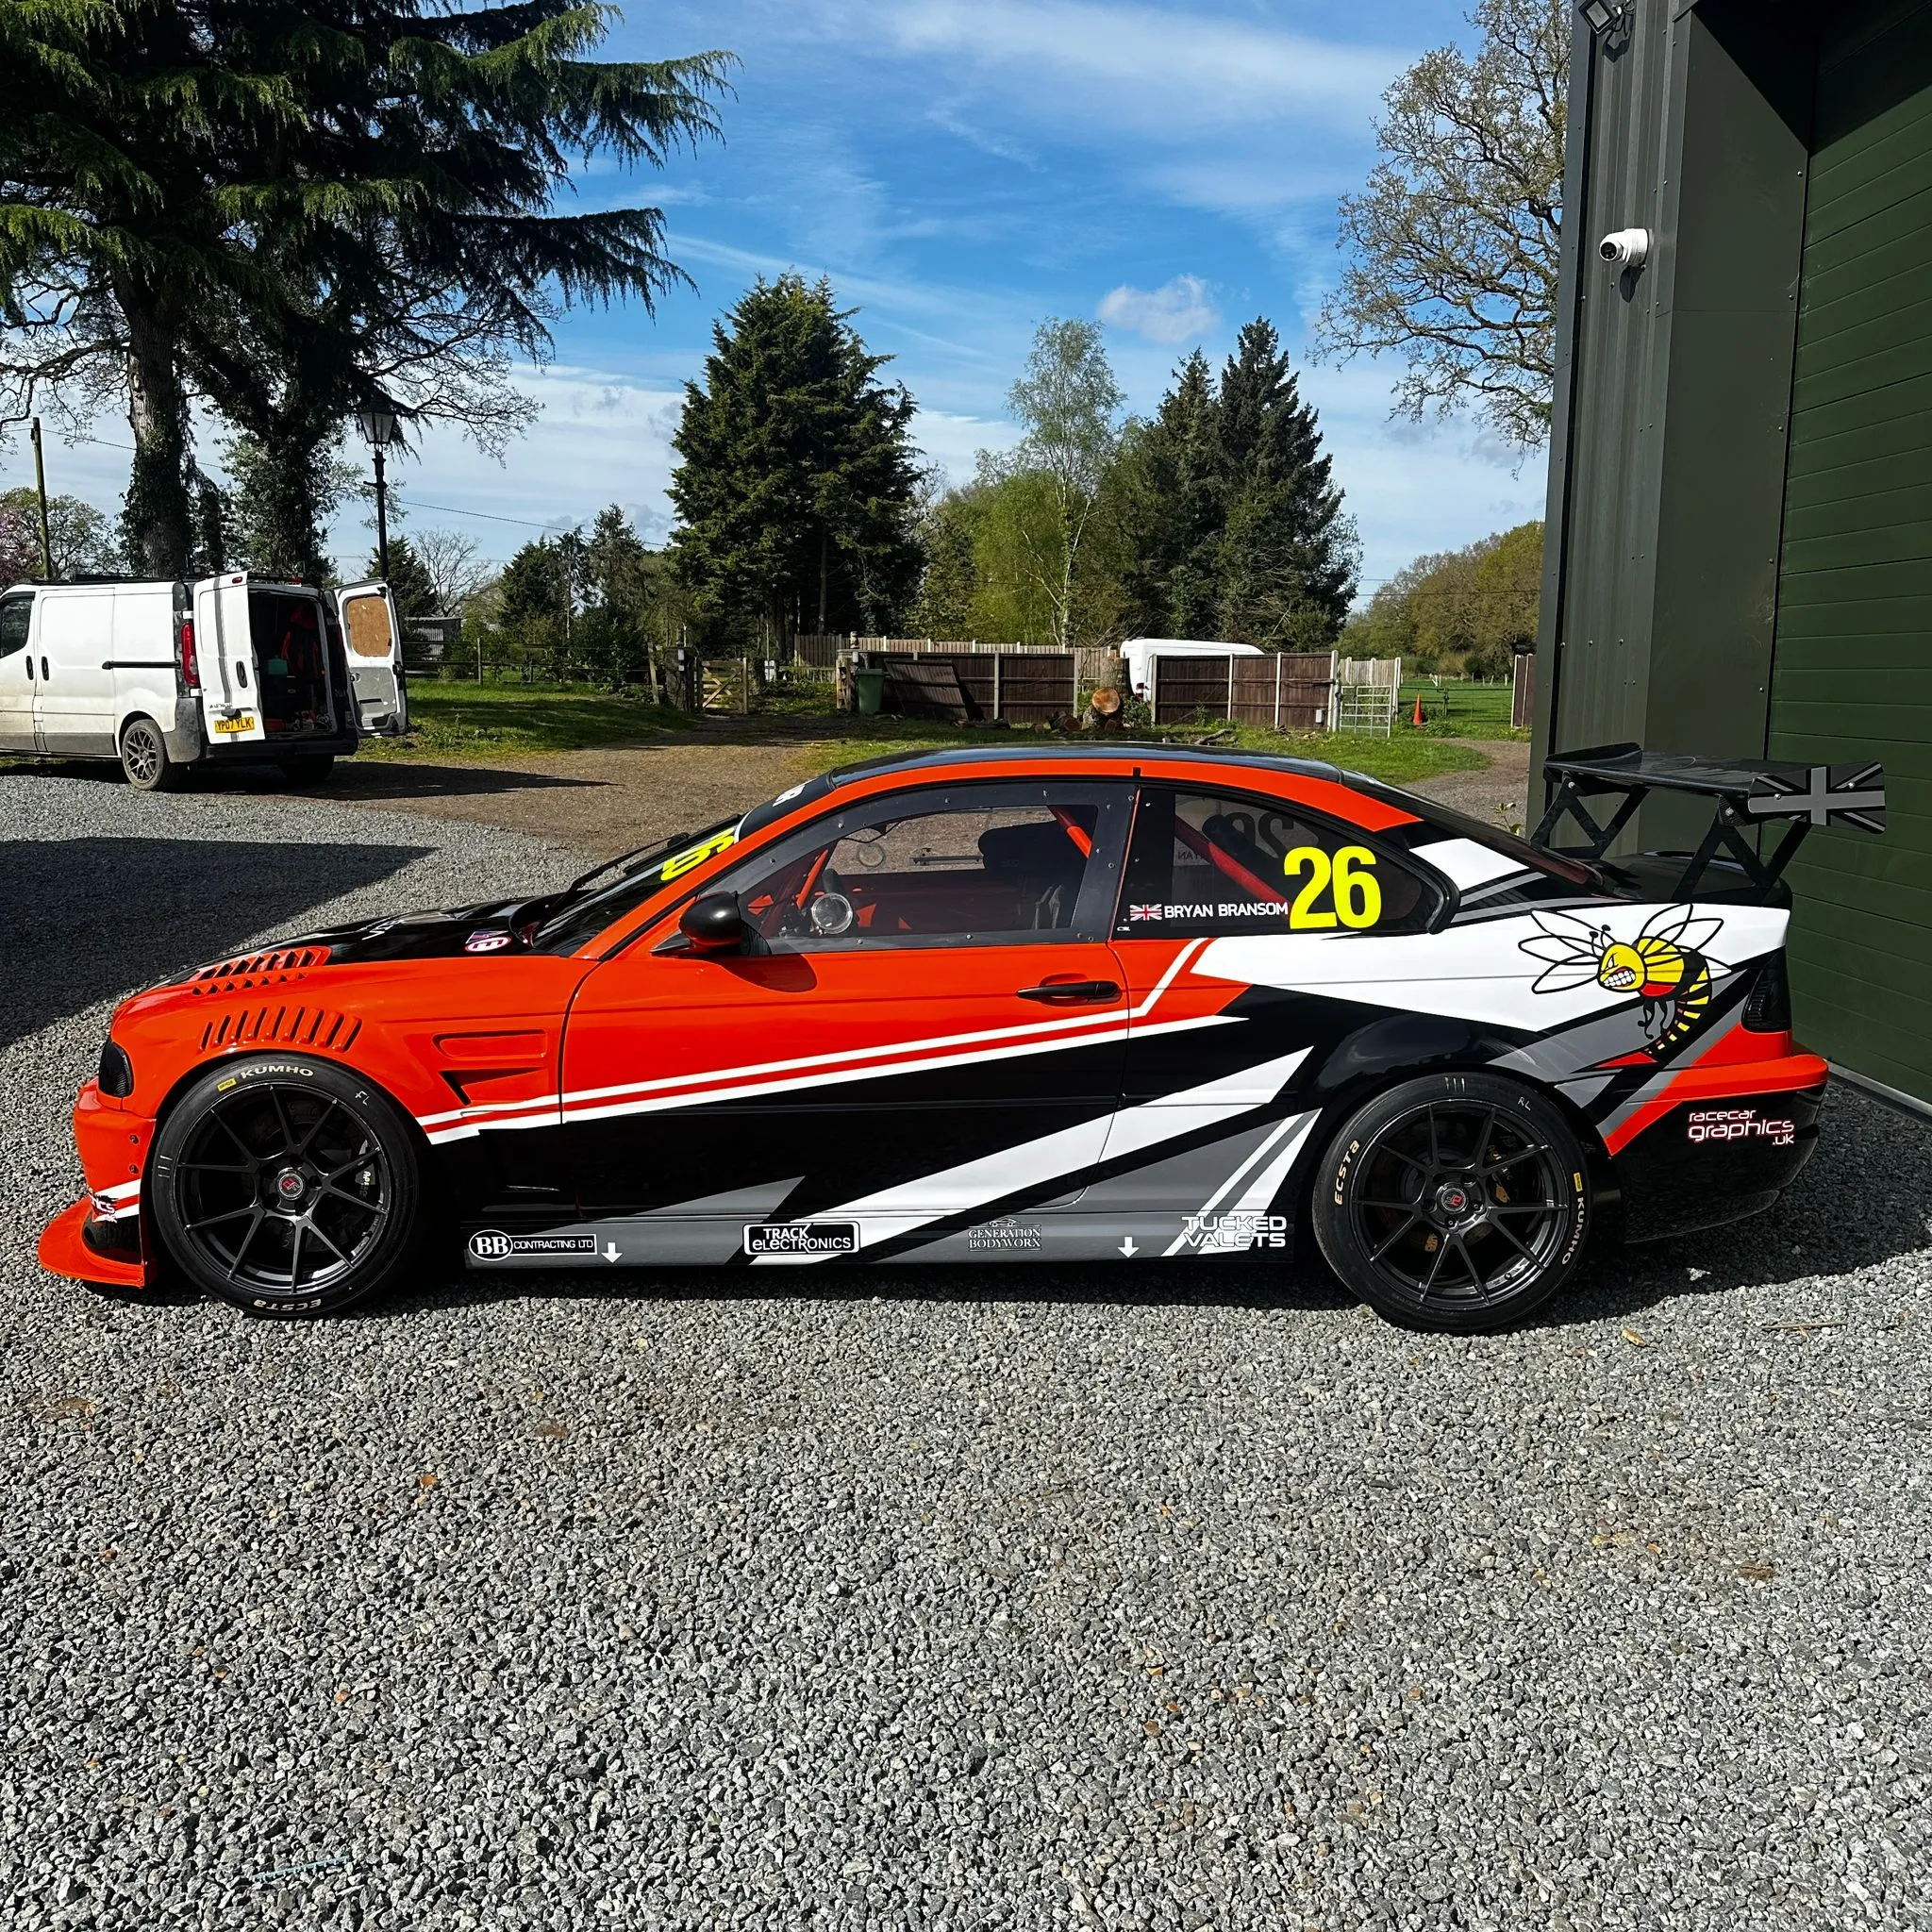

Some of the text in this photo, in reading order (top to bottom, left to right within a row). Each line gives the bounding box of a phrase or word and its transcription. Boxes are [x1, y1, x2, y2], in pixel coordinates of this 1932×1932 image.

[236, 717, 251, 728] YLK
[1284, 845, 1382, 929] 26
[1164, 902, 1289, 919] BRYAN BRANSOM
[240, 1065, 314, 1079] KUMHO
[1517, 1096, 1531, 1111] RL
[1689, 1109, 1757, 1123] racecar
[1688, 1119, 1795, 1142] graphics
[1772, 1133, 1794, 1146] .uk
[1181, 1216, 1287, 1231] TUCKED
[1561, 1196, 1585, 1265] KUMHO
[762, 1225, 808, 1240] TRACK
[968, 1228, 1041, 1239] GENERATION
[1183, 1232, 1286, 1247] VALETS
[475, 1236, 593, 1255] BB CONTRACTING LTD
[969, 1238, 1041, 1248] BODYWORX
